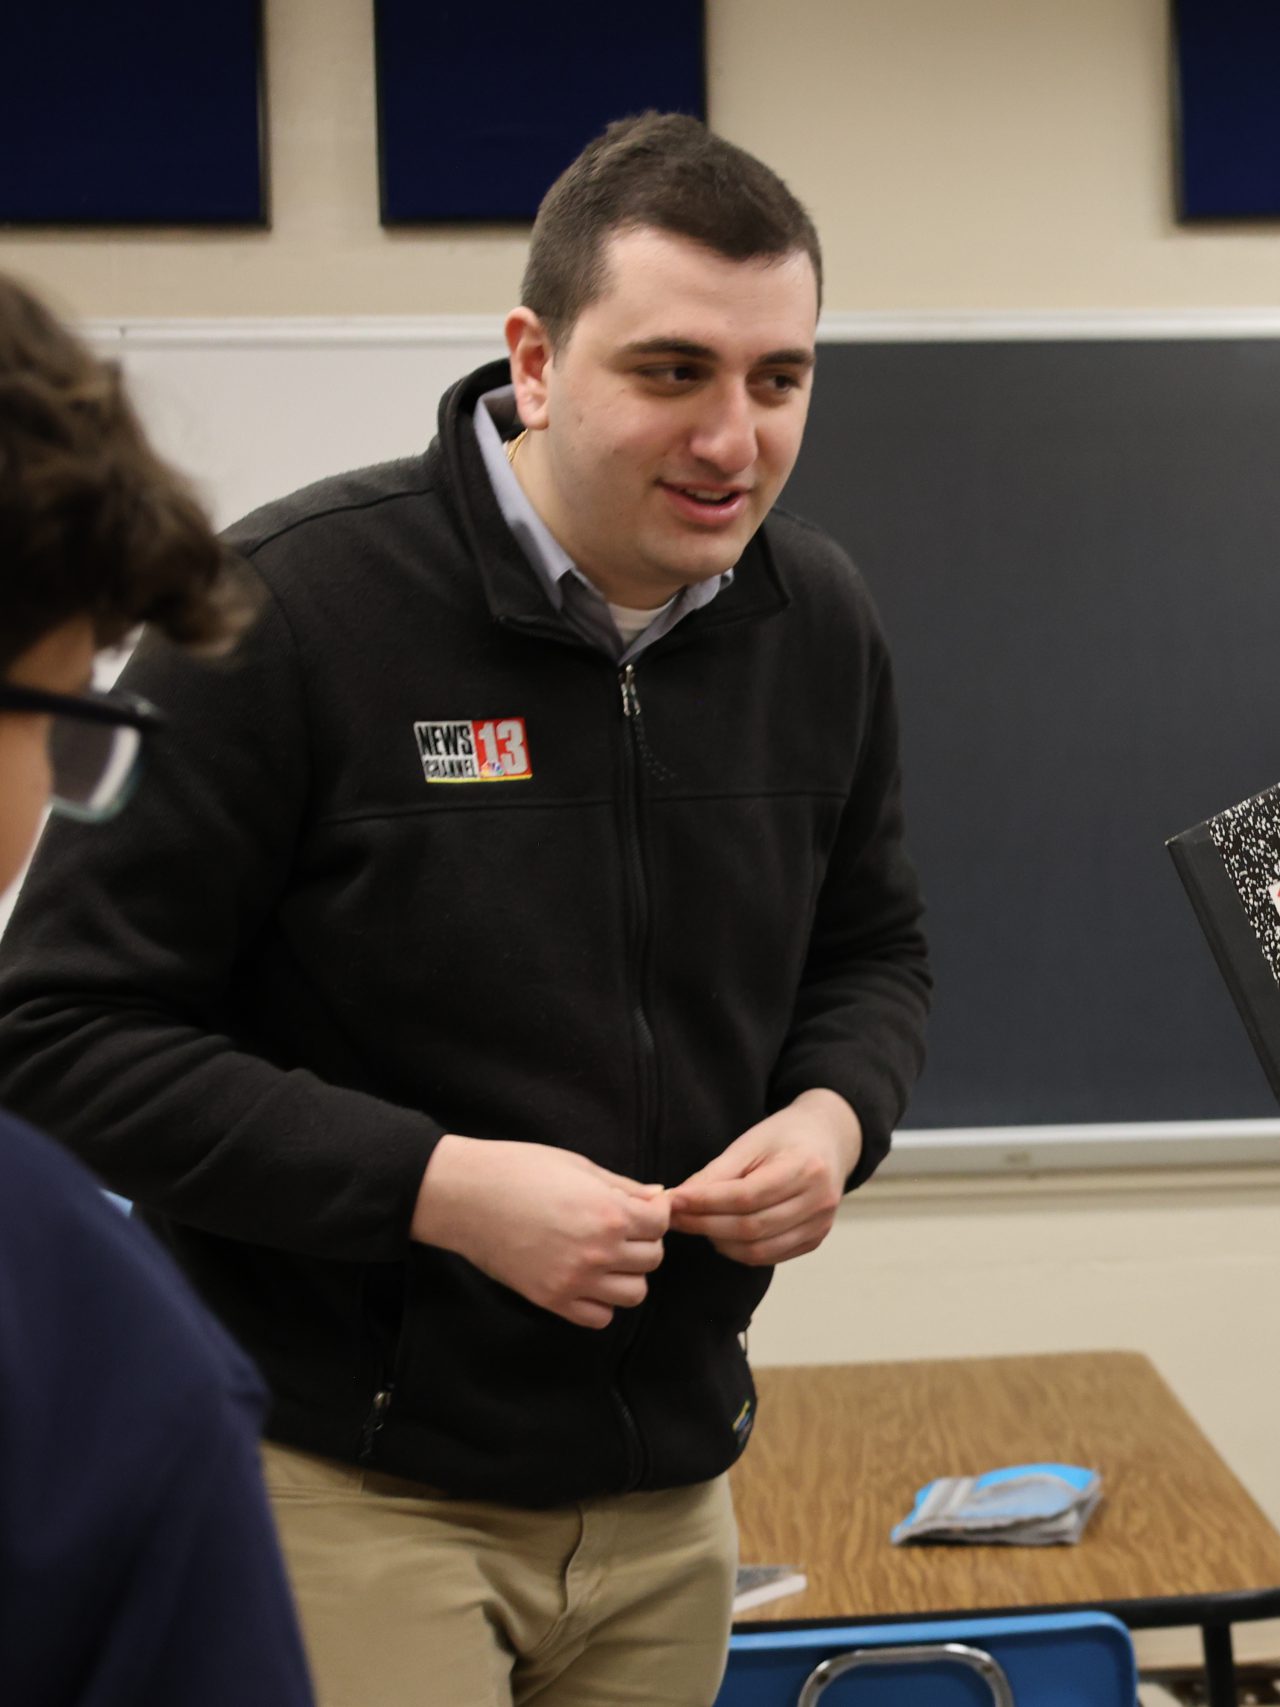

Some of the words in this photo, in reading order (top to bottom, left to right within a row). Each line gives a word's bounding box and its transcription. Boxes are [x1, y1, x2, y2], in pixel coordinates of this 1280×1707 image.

[417, 725, 473, 755] NEWS
[478, 720, 529, 775] 13
[424, 759, 478, 778] CHANNEL
